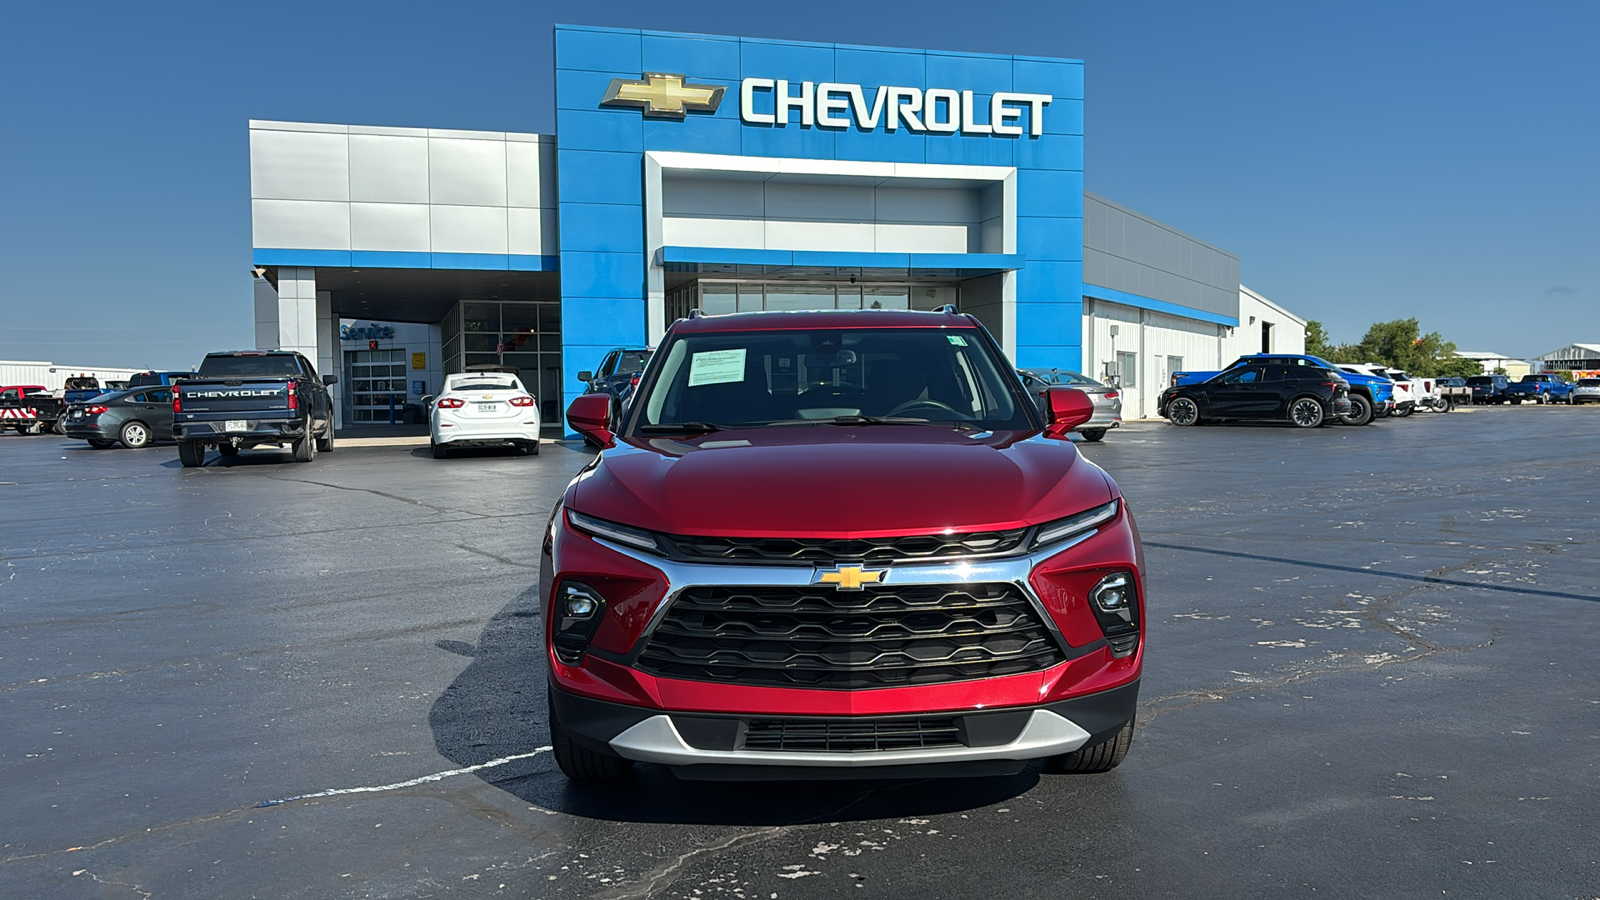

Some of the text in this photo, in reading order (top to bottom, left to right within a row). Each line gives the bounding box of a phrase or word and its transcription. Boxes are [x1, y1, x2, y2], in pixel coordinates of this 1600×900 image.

[740, 77, 1053, 136] CHEVROLET
[340, 323, 394, 340] Service
[187, 389, 281, 399] CHEVROLET
